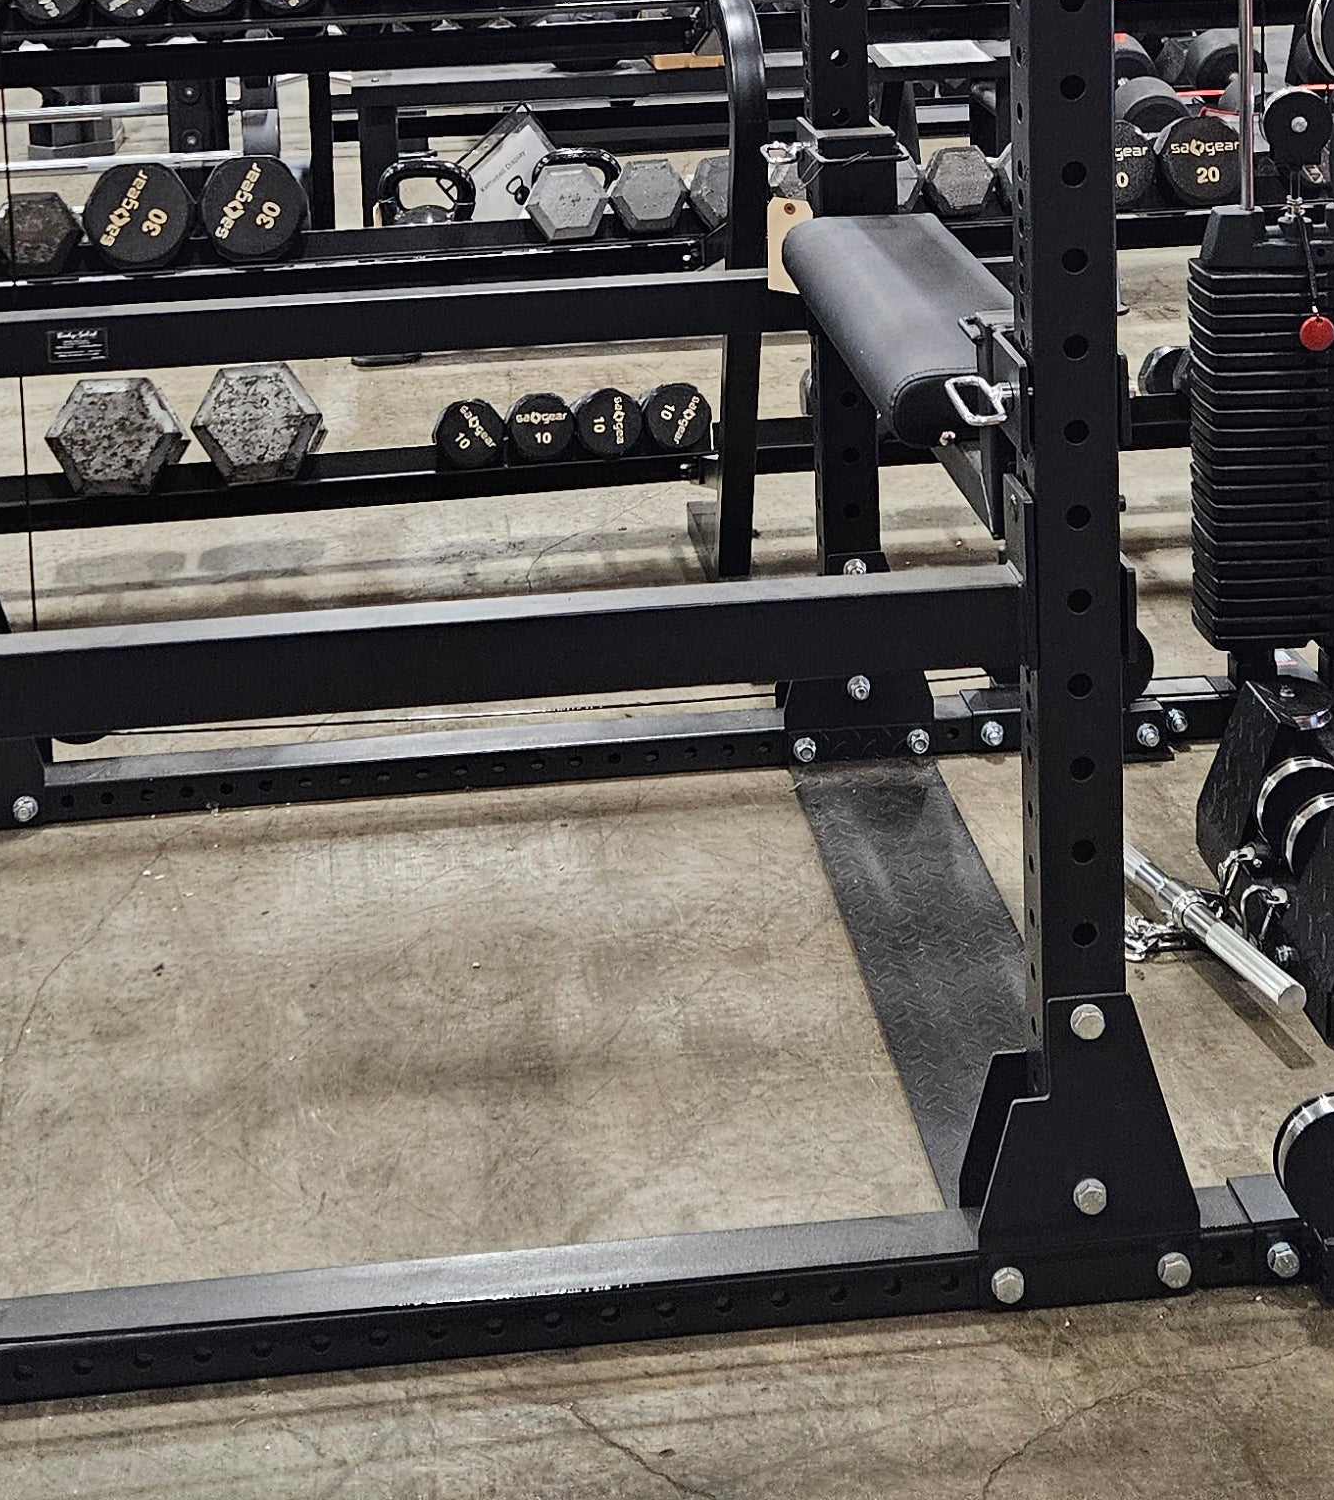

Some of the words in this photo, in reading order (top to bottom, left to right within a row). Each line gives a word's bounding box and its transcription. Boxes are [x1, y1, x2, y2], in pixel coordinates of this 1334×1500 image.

[1196, 166, 1220, 184] 20
[141, 207, 169, 237] 30
[255, 200, 282, 230] 30
[660, 403, 676, 421] 10
[591, 415, 607, 434] 10
[454, 431, 471, 450] 10
[534, 431, 552, 445] 10
